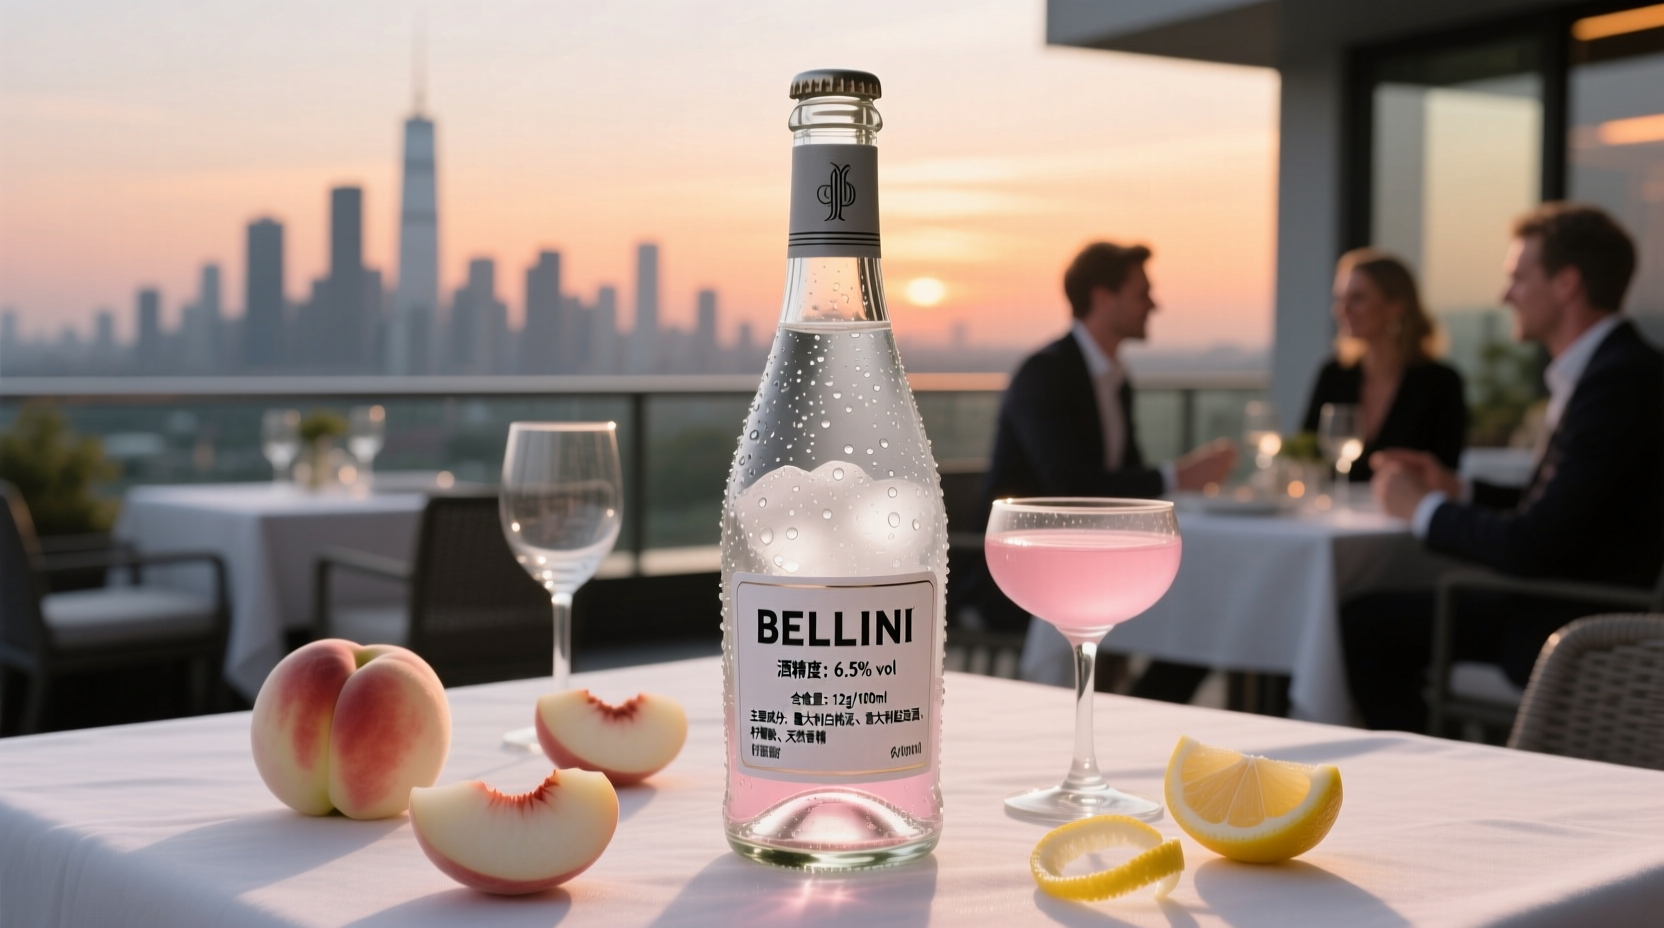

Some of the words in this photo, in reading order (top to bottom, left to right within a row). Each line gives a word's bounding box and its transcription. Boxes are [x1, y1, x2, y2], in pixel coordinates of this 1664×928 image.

[757, 608, 912, 646] BELLINI
[777, 659, 828, 679] 酒精度:
[834, 661, 872, 678] 6.5%
[876, 659, 896, 676] vol
